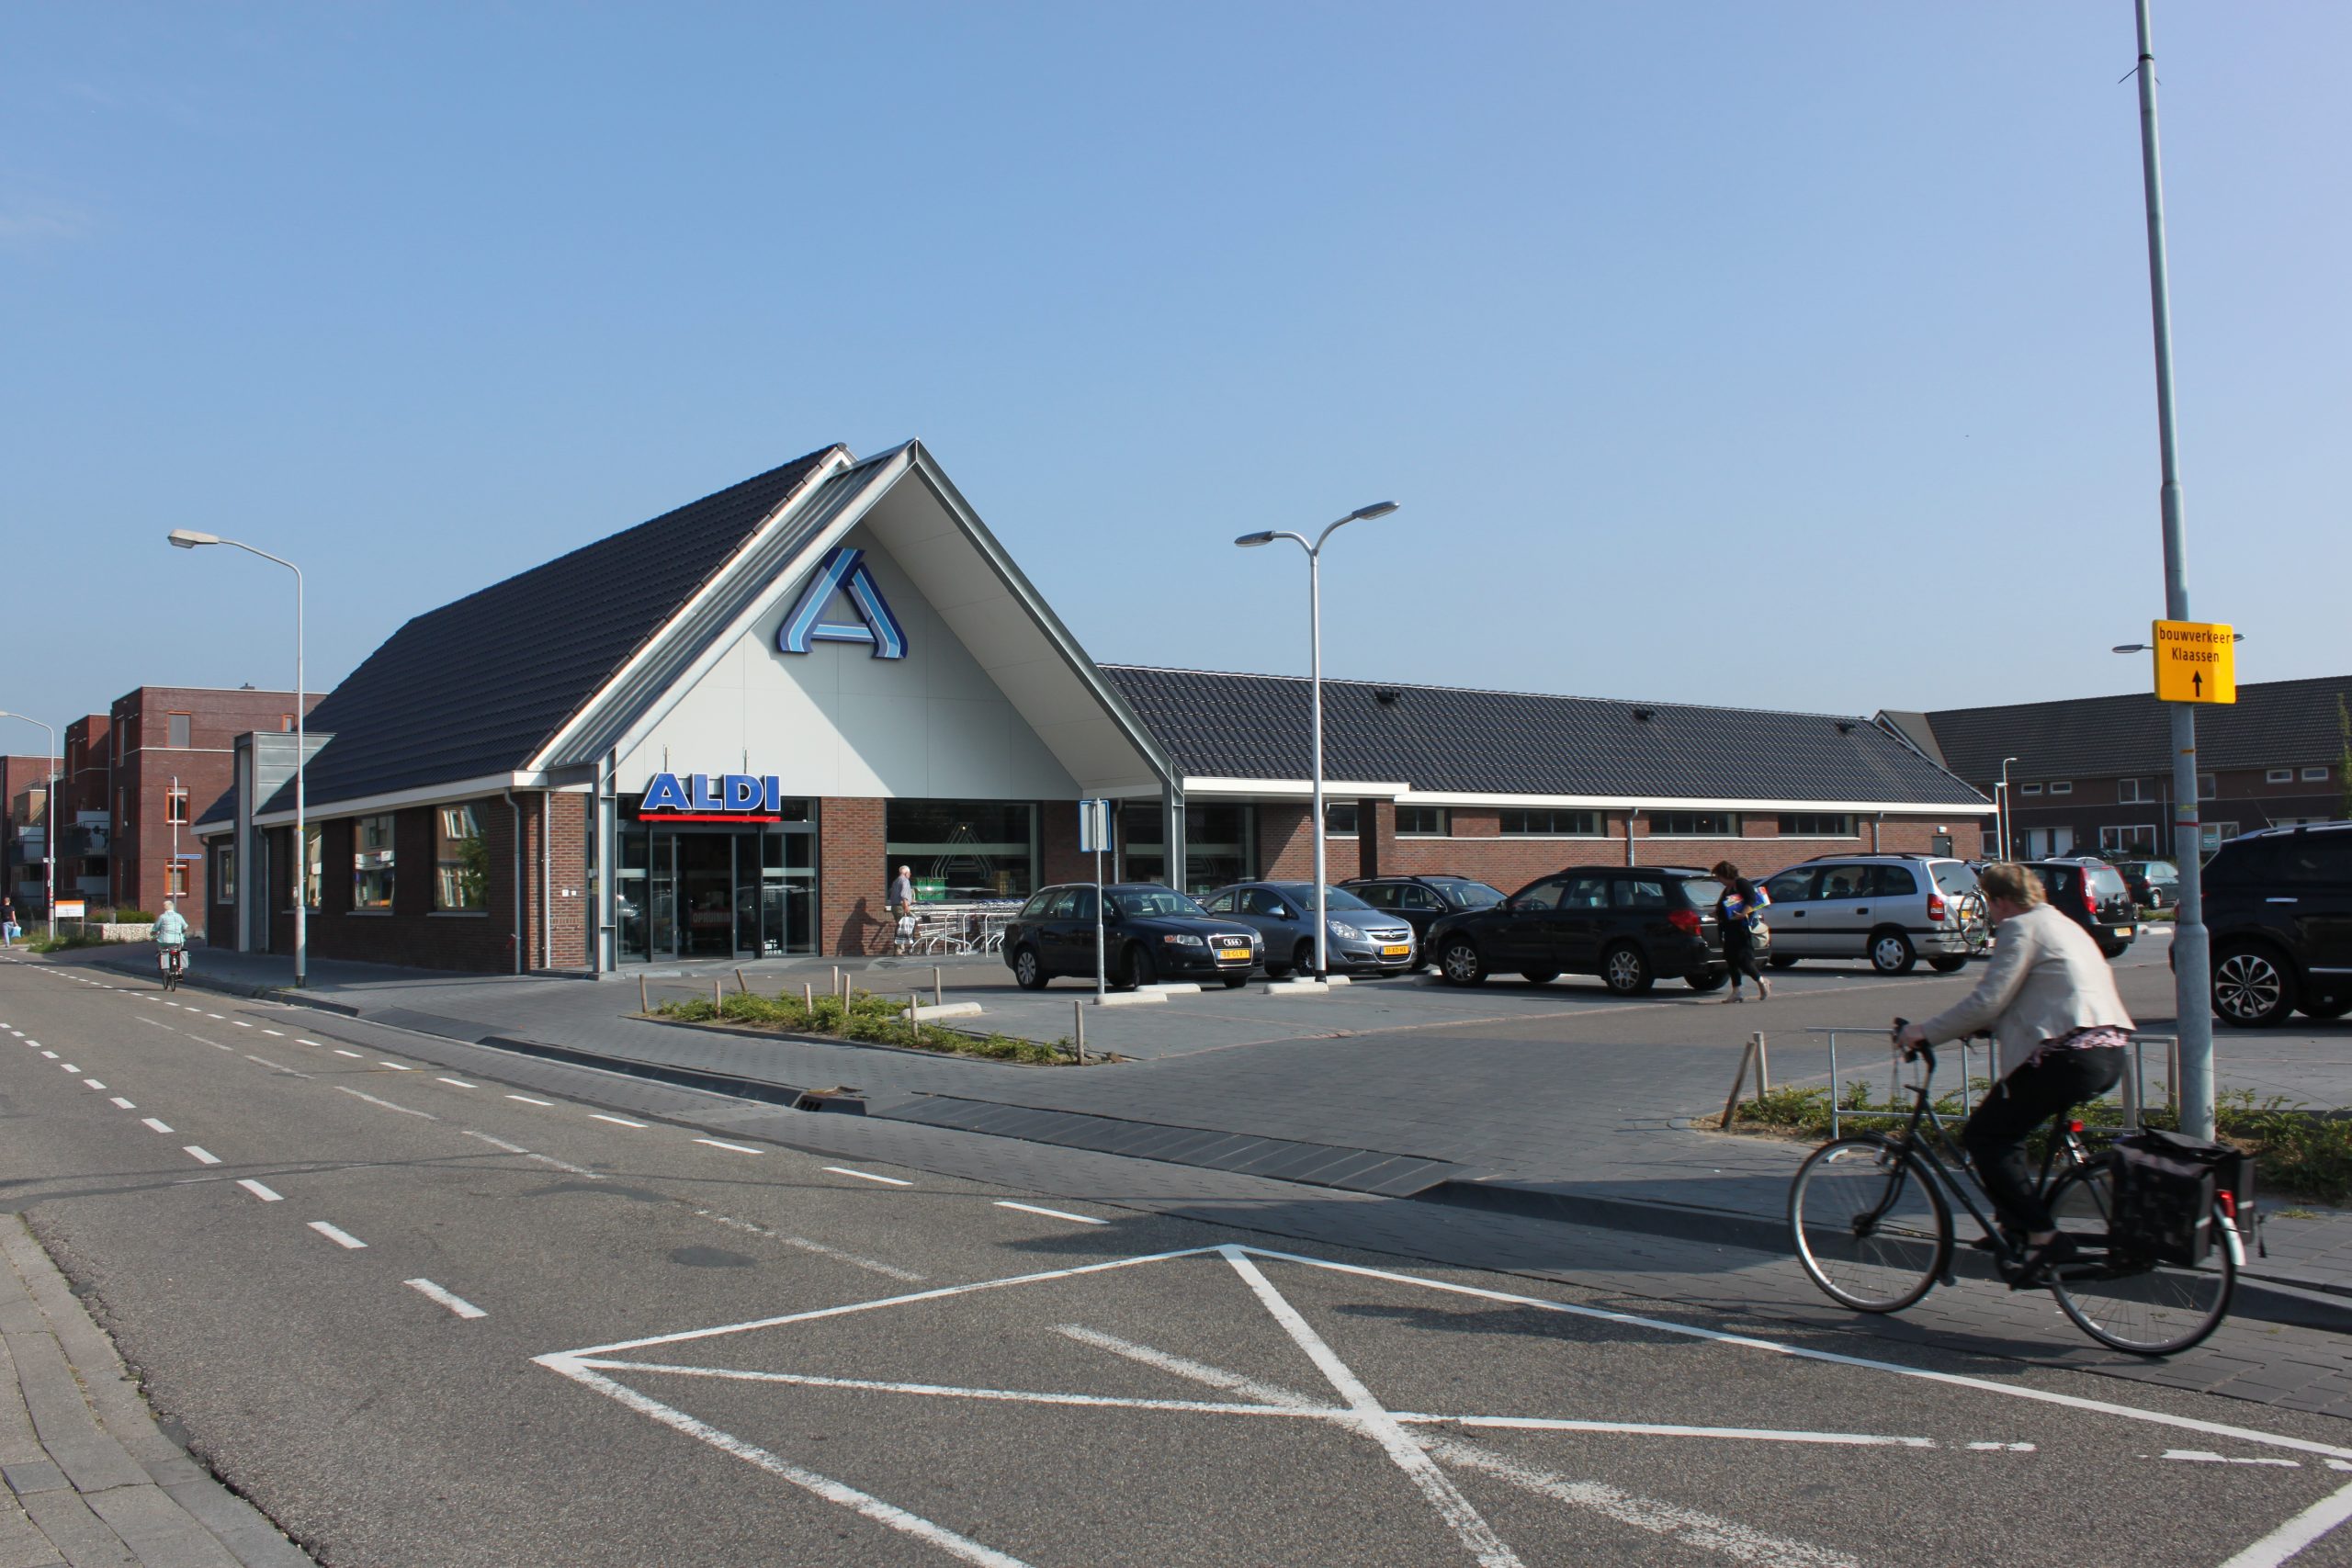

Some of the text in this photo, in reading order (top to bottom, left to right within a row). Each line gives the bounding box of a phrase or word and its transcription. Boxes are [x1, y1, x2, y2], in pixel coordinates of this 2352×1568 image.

[2159, 626, 2231, 644] bouwverkeer
[2171, 647, 2220, 662] Klaassen
[640, 773, 781, 812] ALDI
